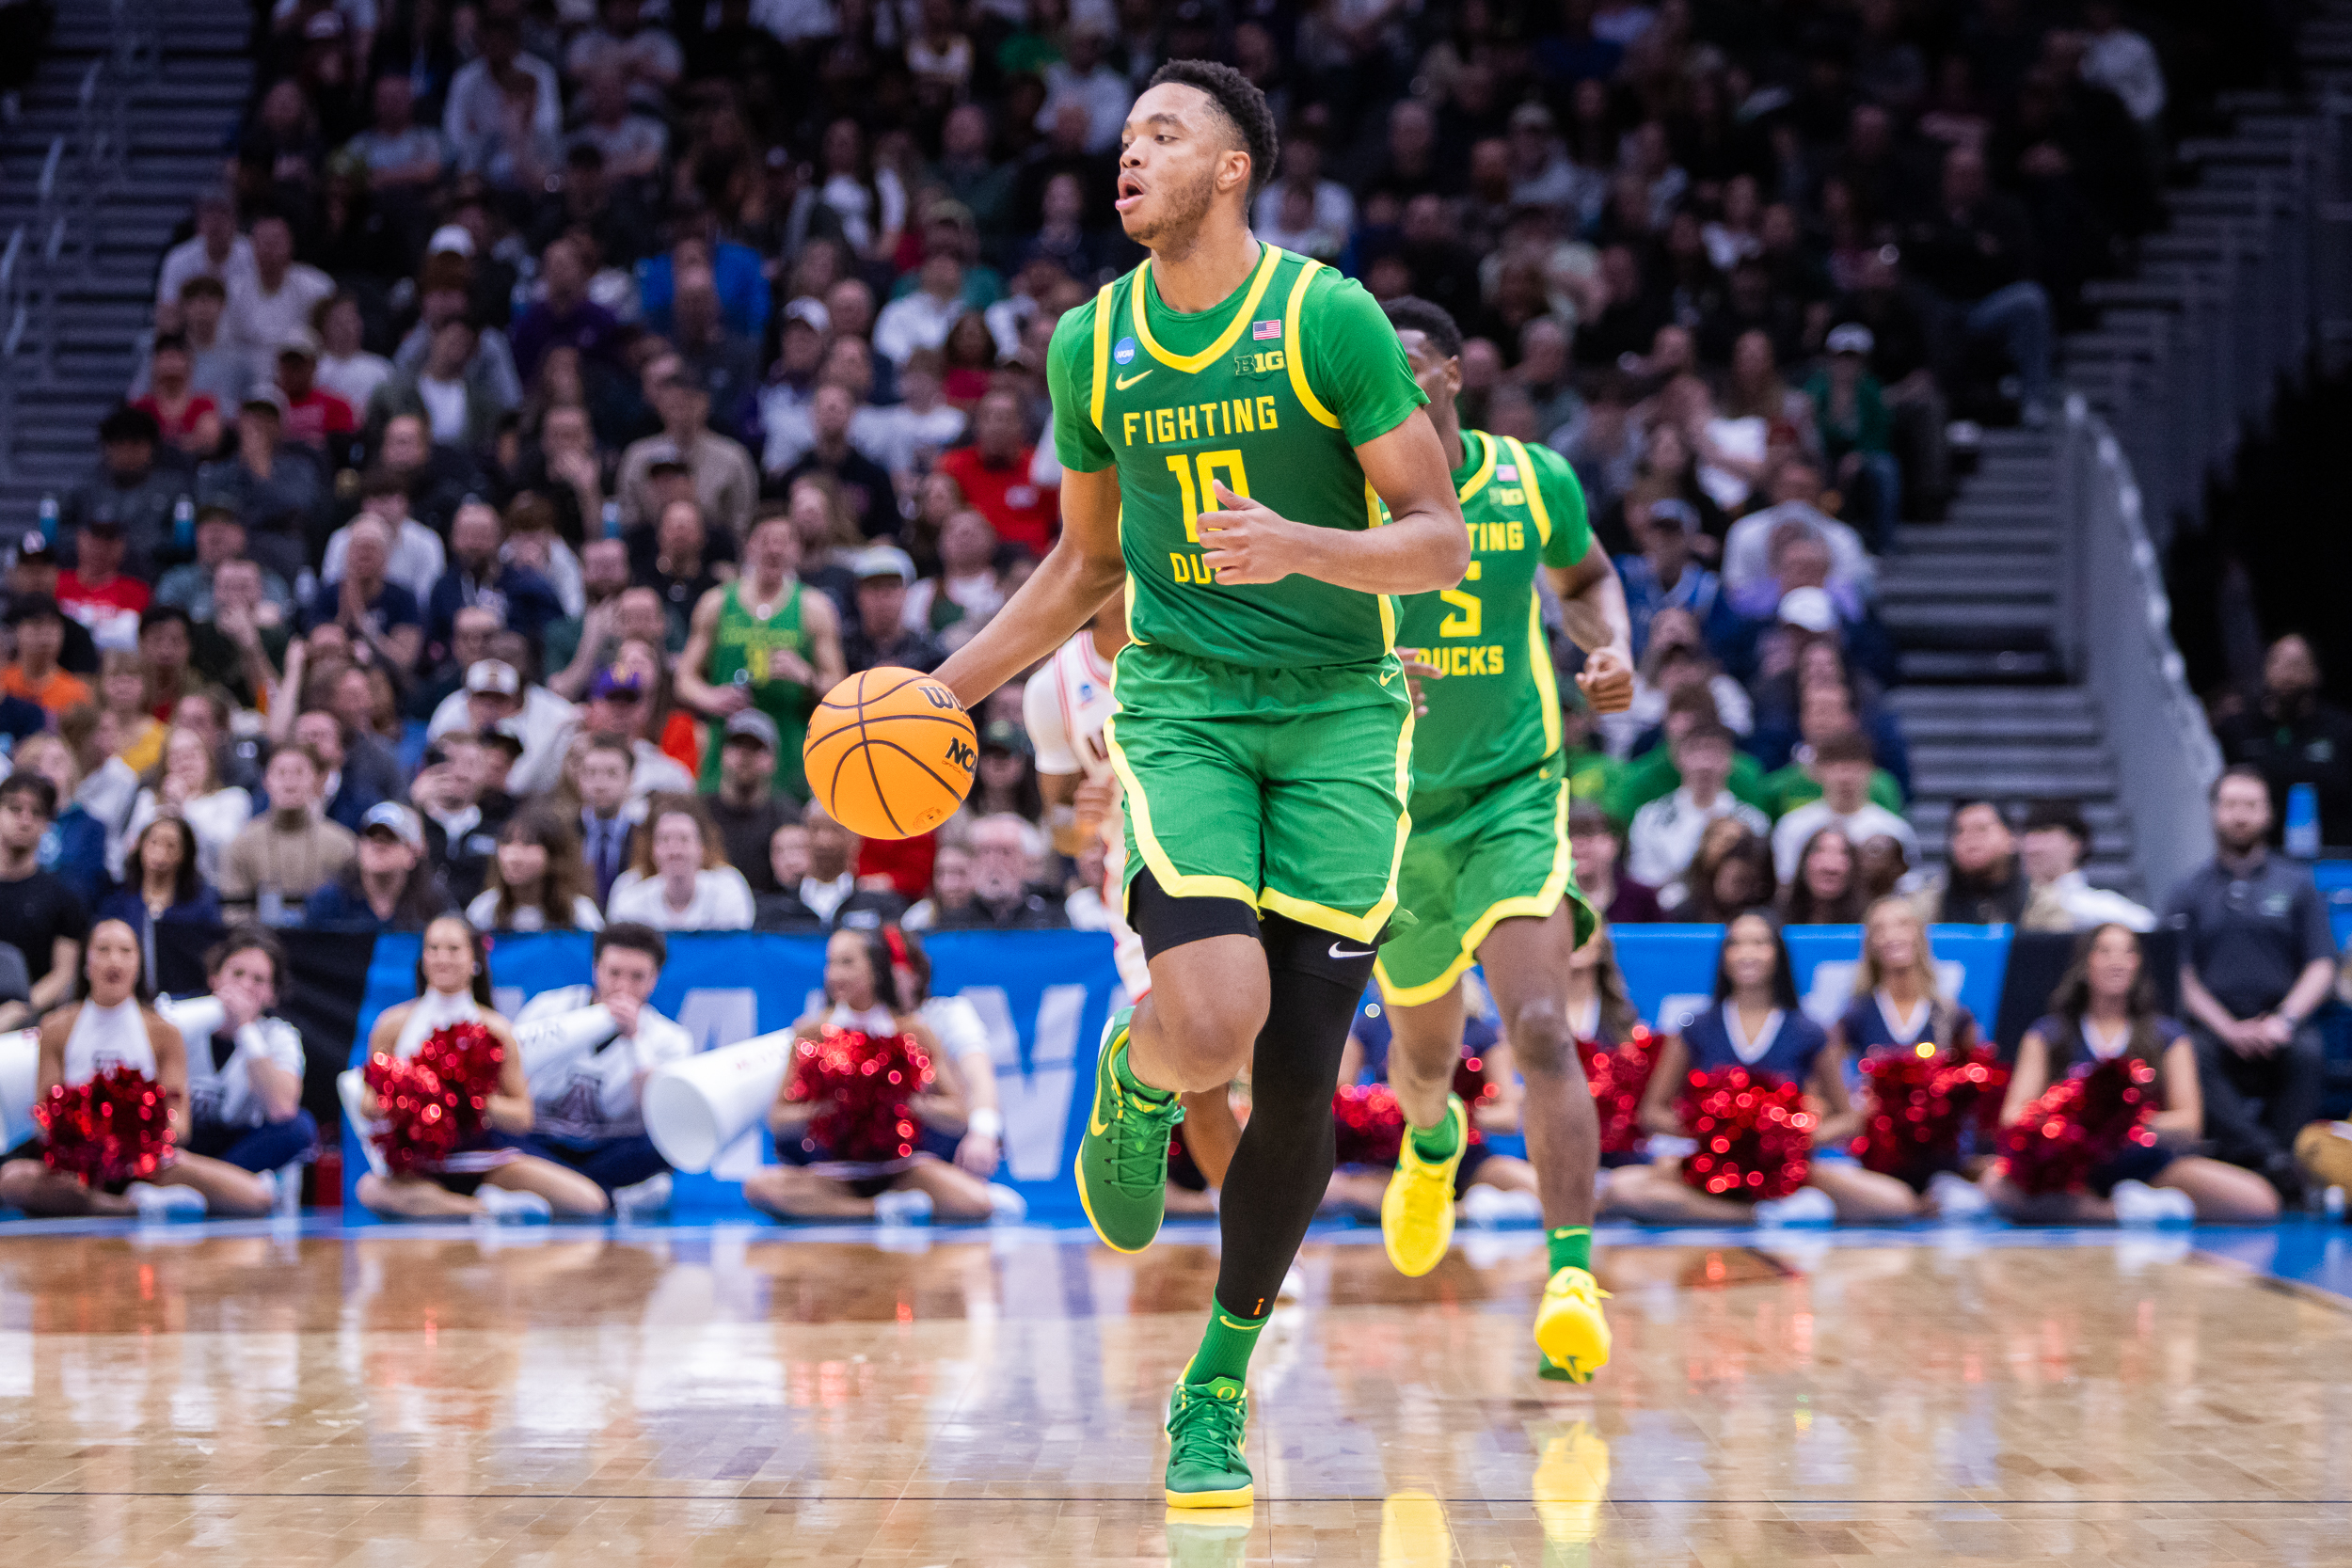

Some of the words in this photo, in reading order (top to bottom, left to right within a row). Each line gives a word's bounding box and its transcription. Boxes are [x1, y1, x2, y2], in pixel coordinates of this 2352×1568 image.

[1123, 395, 1279, 446] FIGHTING
[1166, 449, 1250, 544] 10
[1466, 521, 1525, 552] TING
[1439, 560, 1482, 638] 5
[944, 736, 977, 780] NC
